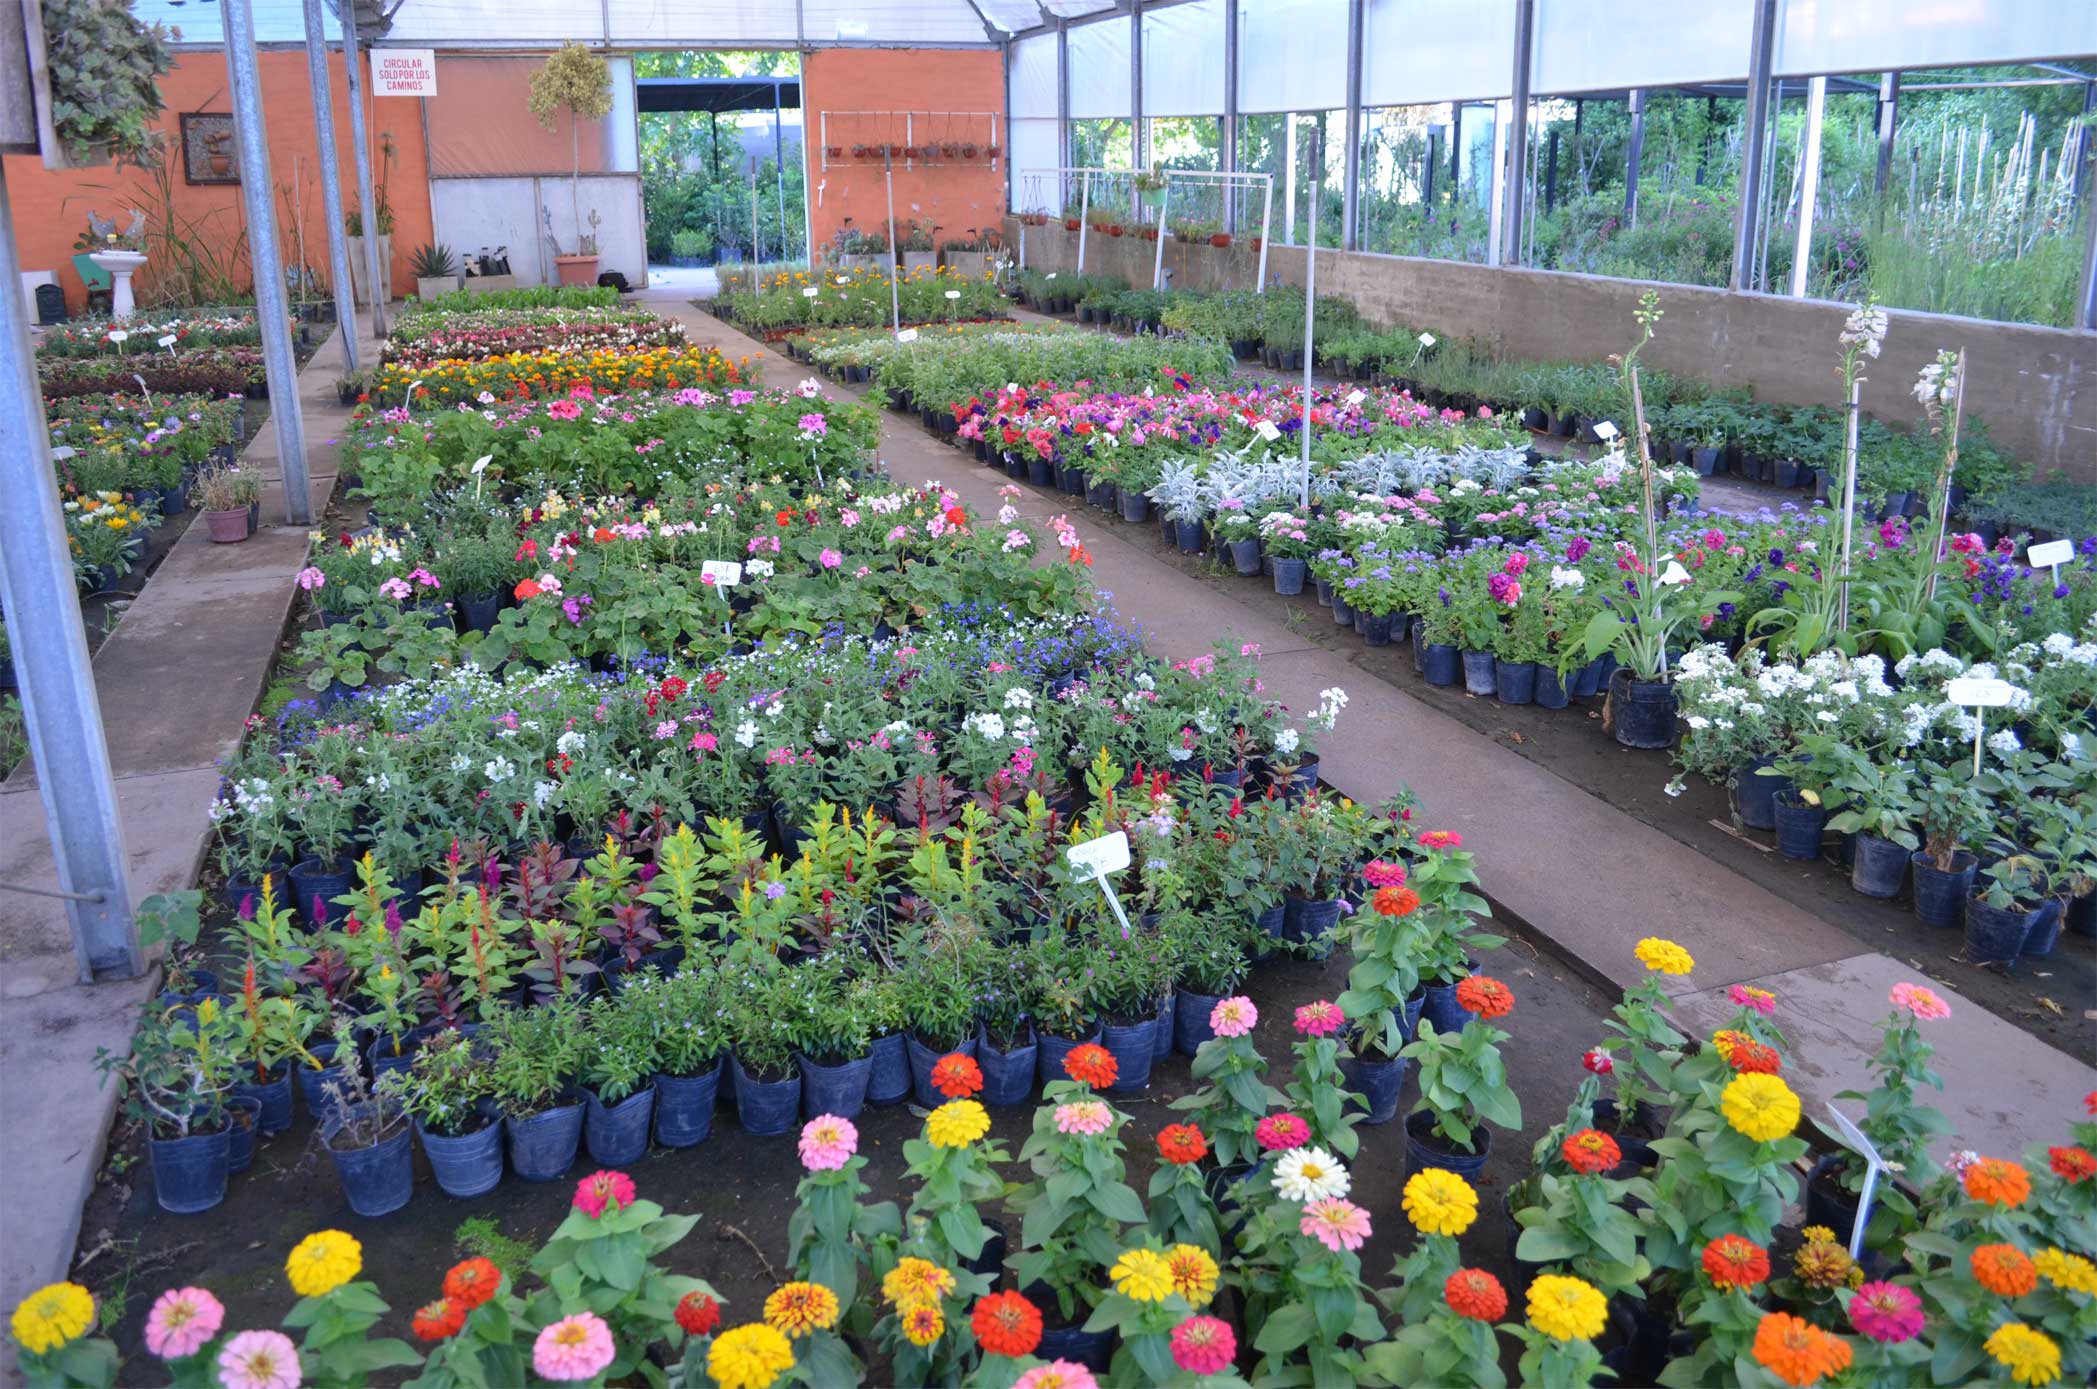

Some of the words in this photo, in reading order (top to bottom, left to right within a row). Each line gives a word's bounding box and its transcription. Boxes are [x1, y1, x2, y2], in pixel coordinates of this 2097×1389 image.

[383, 59, 422, 69] CIRCULAR
[379, 70, 398, 80] SOLO
[399, 70, 414, 80] POR
[415, 70, 430, 80] LOS
[386, 80, 423, 90] CAMINOS
